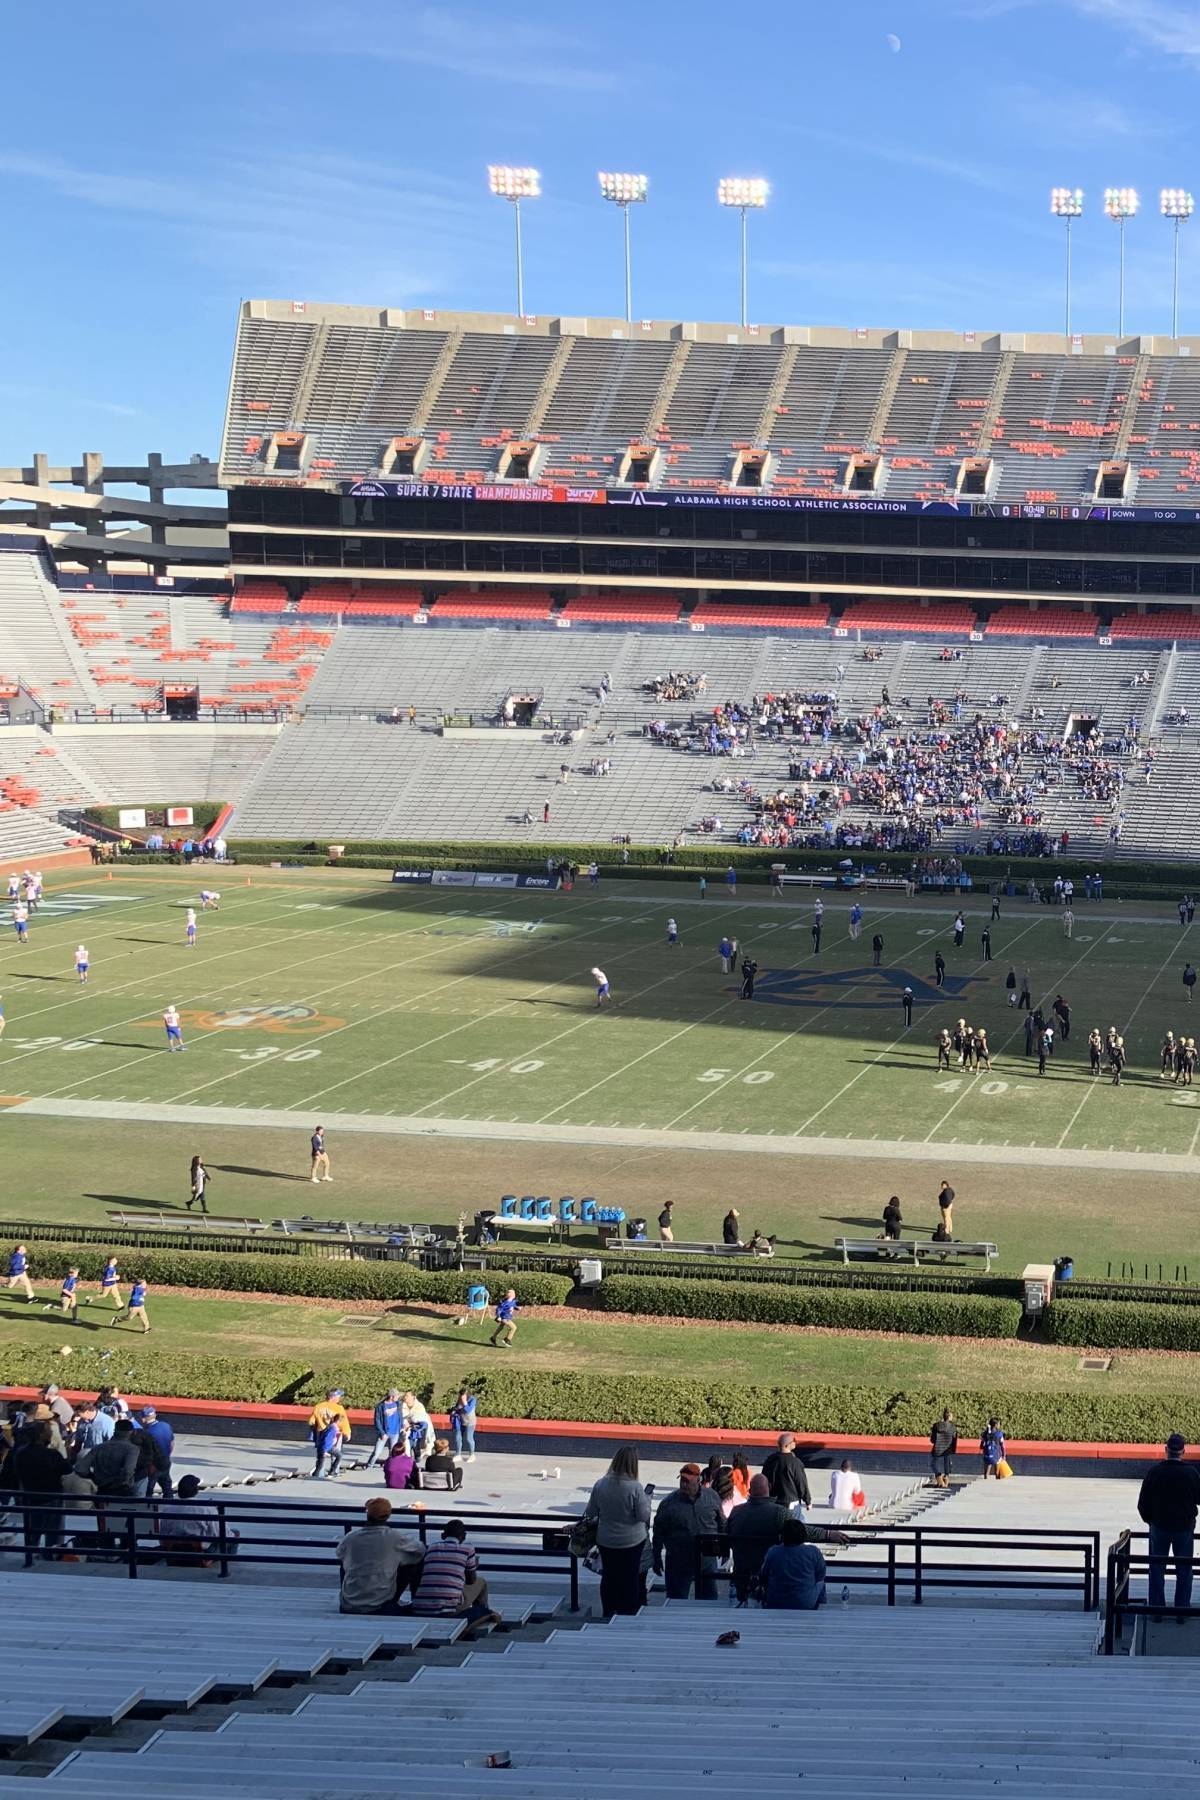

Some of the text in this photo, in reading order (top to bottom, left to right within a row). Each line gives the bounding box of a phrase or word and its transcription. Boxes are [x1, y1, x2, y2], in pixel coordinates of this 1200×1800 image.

[397, 485, 429, 497] SUPER
[433, 486, 440, 497] 7
[442, 486, 473, 498] STATE
[475, 486, 553, 502] CHAMPIONSHIPS
[675, 496, 907, 511] ALABAMA HIGH SCHOOL ATHLETIC ASSOCIATION
[1002, 505, 1010, 517] 0
[1072, 507, 1080, 518] 0
[240, 1046, 322, 1062] 30
[467, 1057, 546, 1074] 40
[696, 1068, 776, 1084] 50
[933, 1078, 1012, 1095] 40
